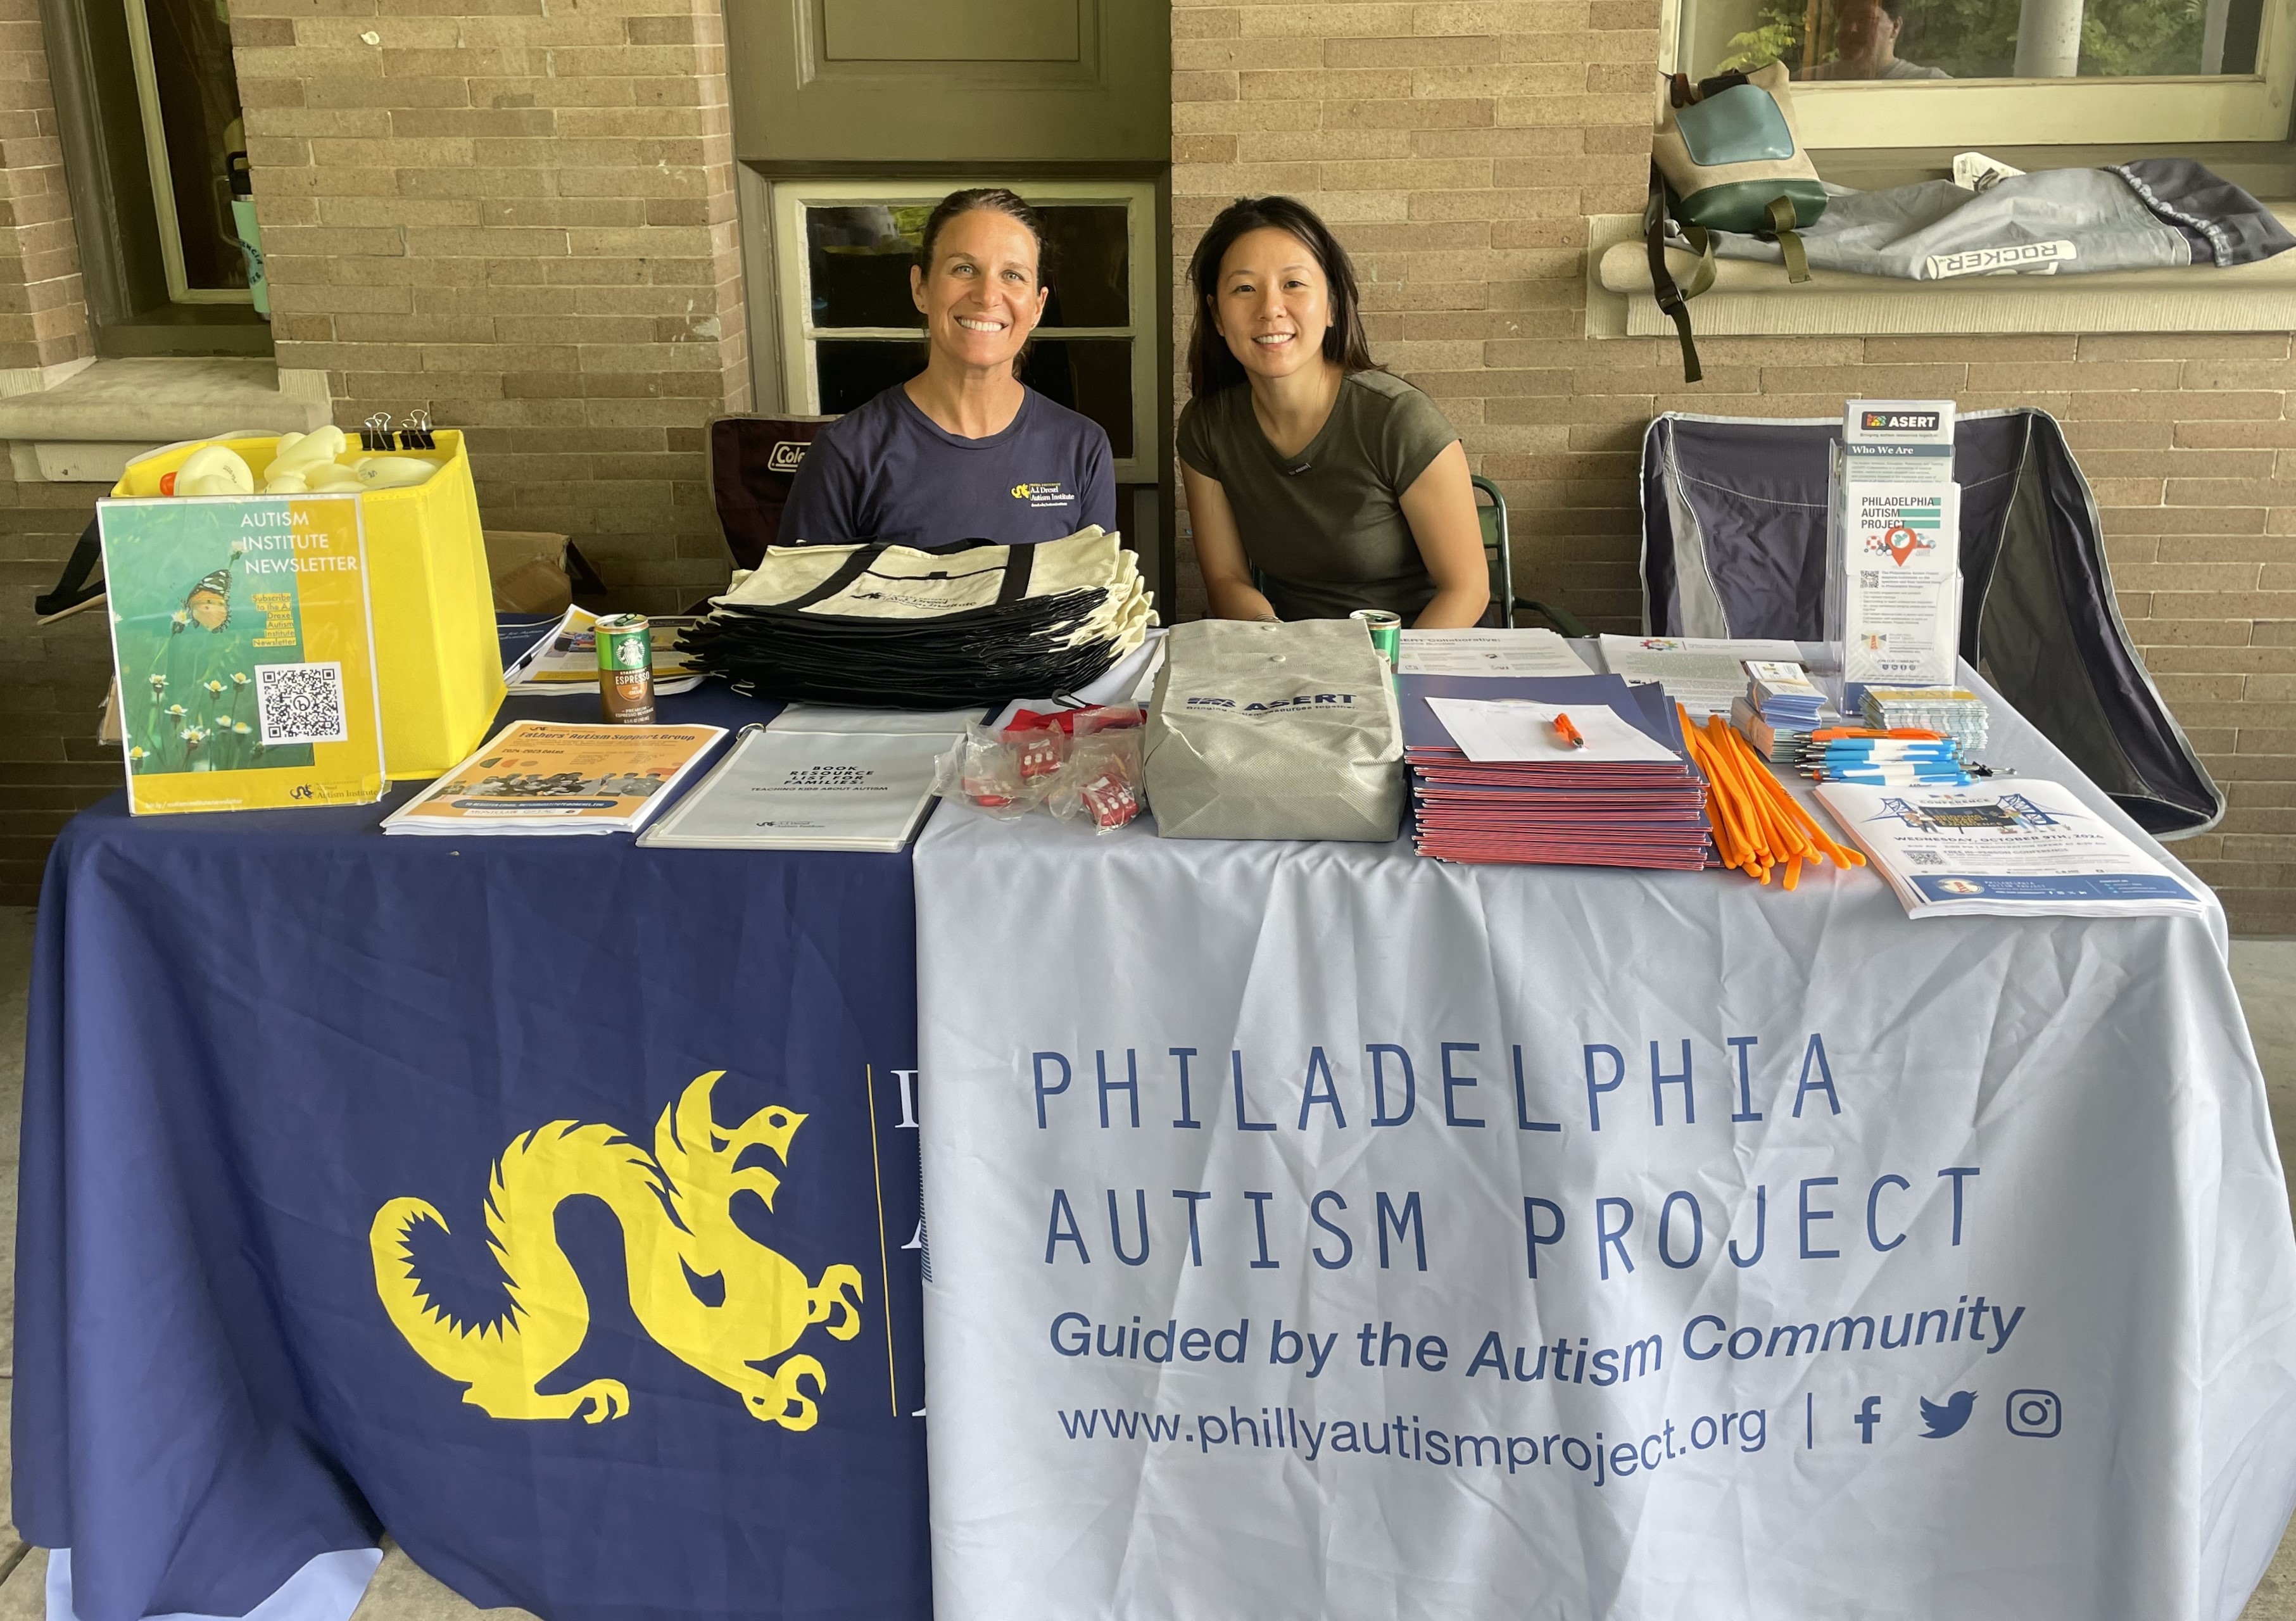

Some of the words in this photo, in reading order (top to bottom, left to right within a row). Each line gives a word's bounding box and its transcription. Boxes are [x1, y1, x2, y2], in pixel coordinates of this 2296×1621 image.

[1947, 244, 2058, 271] ROCKER
[1889, 417, 1936, 427] ASERT
[1852, 445, 1875, 454] Who
[1877, 445, 1894, 454] We
[1895, 446, 1914, 454] Are
[1862, 497, 1934, 506] PHILADELPHIA
[241, 511, 309, 527] AUTISM
[1862, 508, 1900, 517] AUTISM
[1862, 520, 1907, 529] PROJECT
[243, 534, 329, 550] INSTITUTE
[245, 557, 357, 574] NEWSLETTER
[615, 671, 650, 685] ESPRESSO
[1244, 694, 1357, 710] ASERT
[1031, 1033, 1843, 1133] PHILADELPHIA
[1044, 1187, 1429, 1272] AUTISM
[1525, 1167, 1981, 1282] PROJECT
[1049, 1311, 1248, 1365] Guided
[1270, 1318, 1337, 1377] by
[1356, 1321, 1448, 1370] the
[1467, 1326, 1663, 1387] Autism
[1682, 1295, 2025, 1359] Community
[1057, 1403, 1767, 1486] www.phillyautismproject.org
